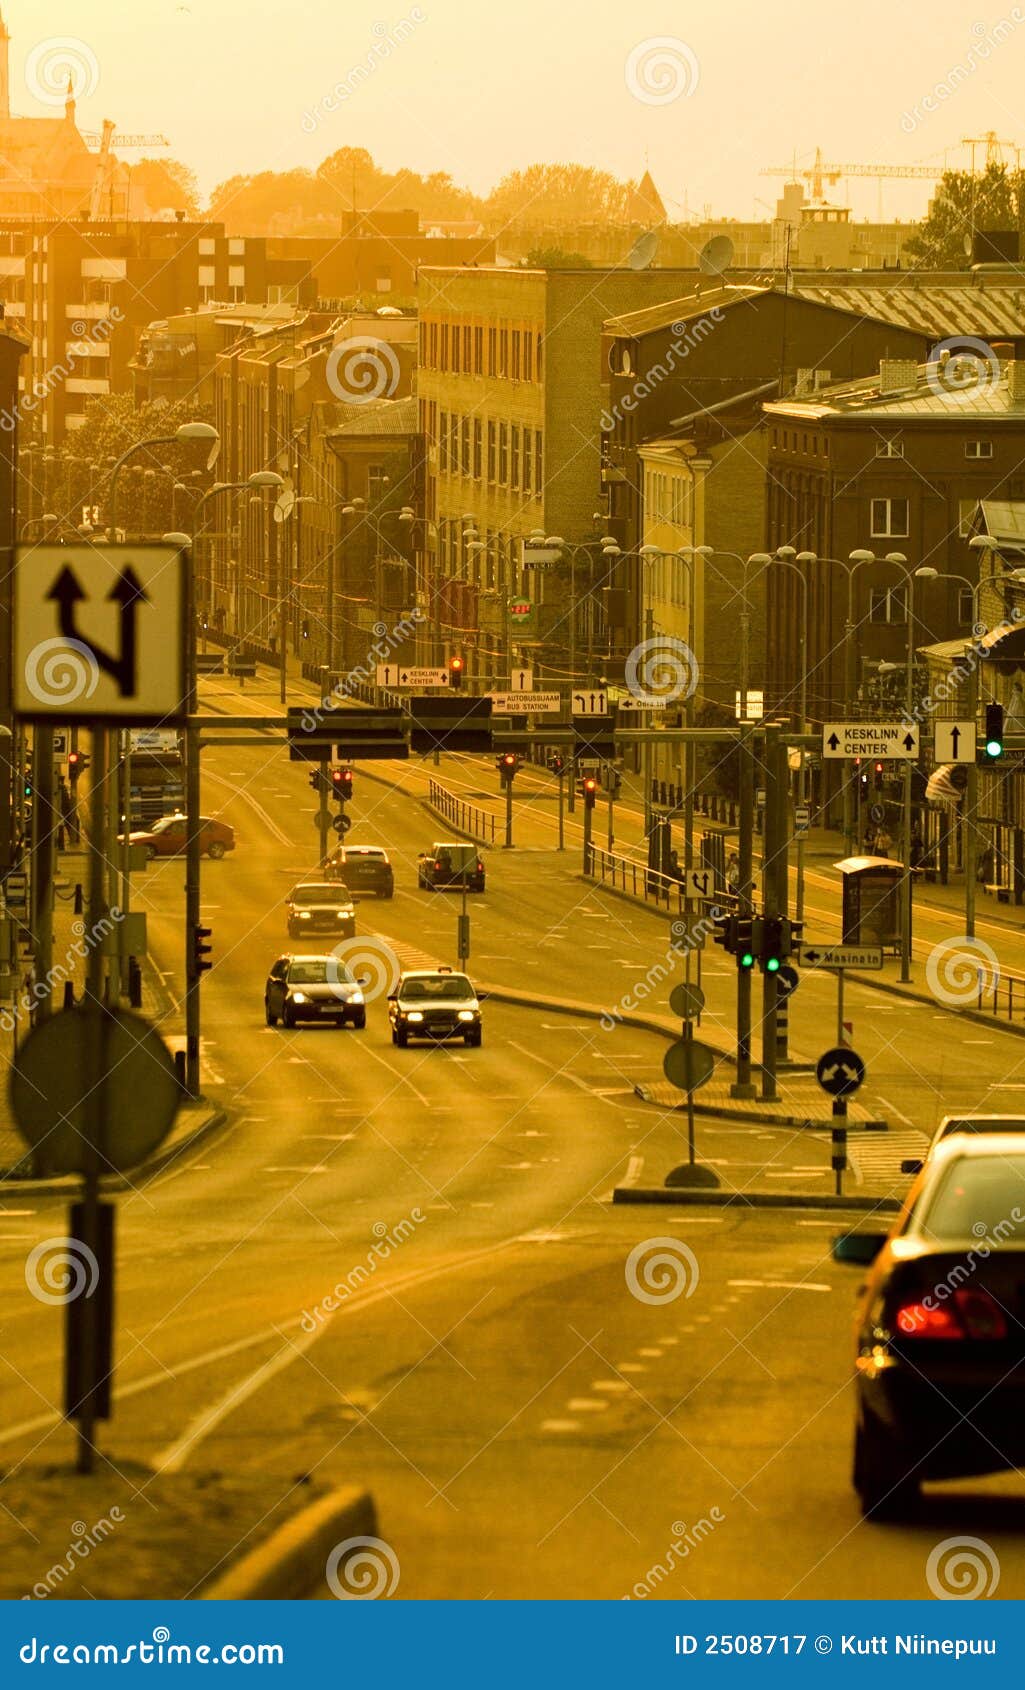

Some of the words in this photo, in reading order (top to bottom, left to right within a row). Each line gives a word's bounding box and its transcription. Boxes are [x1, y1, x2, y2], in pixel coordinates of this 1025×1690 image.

[844, 728, 898, 739] KESKLINN
[844, 743, 888, 754] CENTER
[824, 951, 865, 964] Masina
